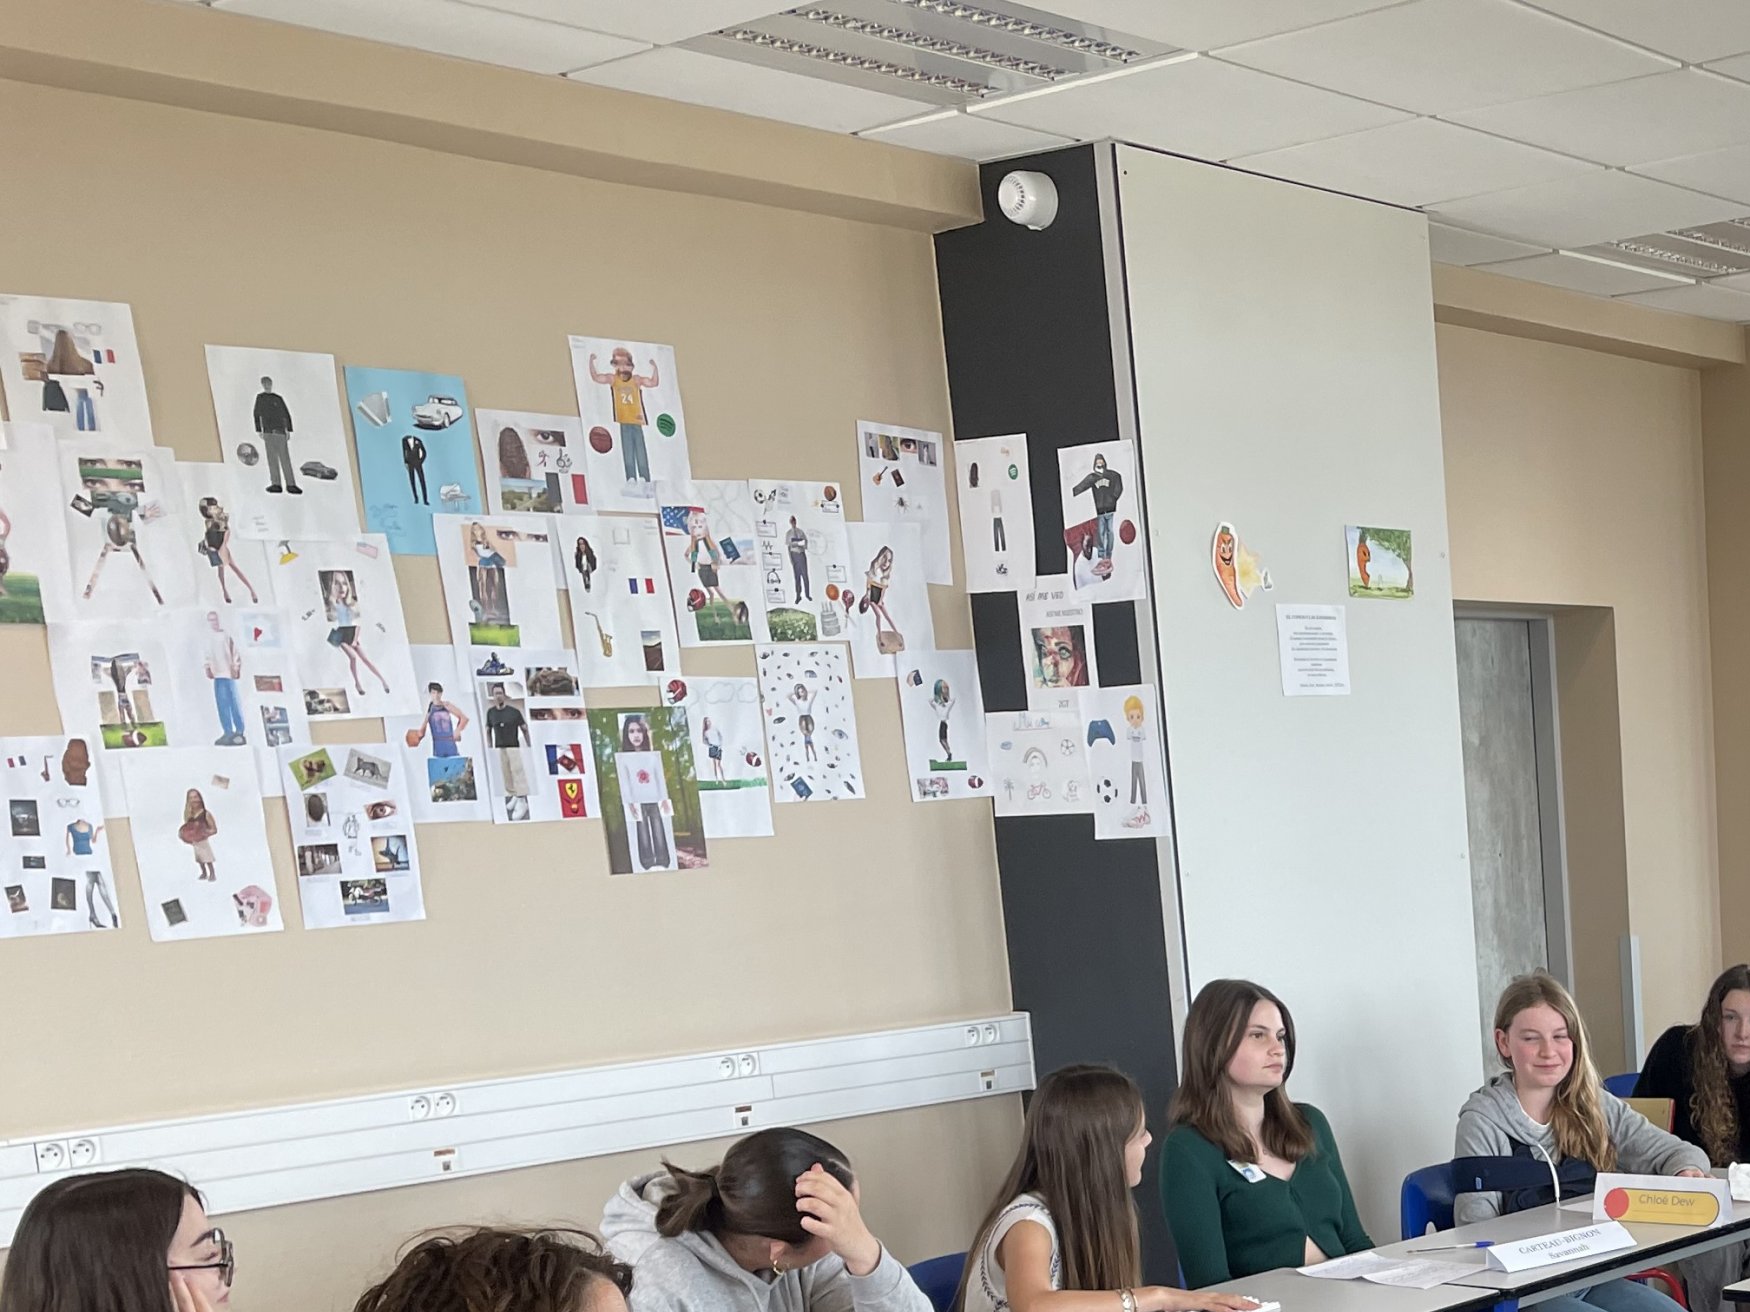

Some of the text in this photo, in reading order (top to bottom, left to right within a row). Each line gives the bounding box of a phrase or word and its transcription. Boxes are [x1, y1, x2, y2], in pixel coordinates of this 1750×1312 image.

[1638, 1194, 1695, 1207] Chloé Dew
[1548, 1243, 1590, 1260] Savannah
